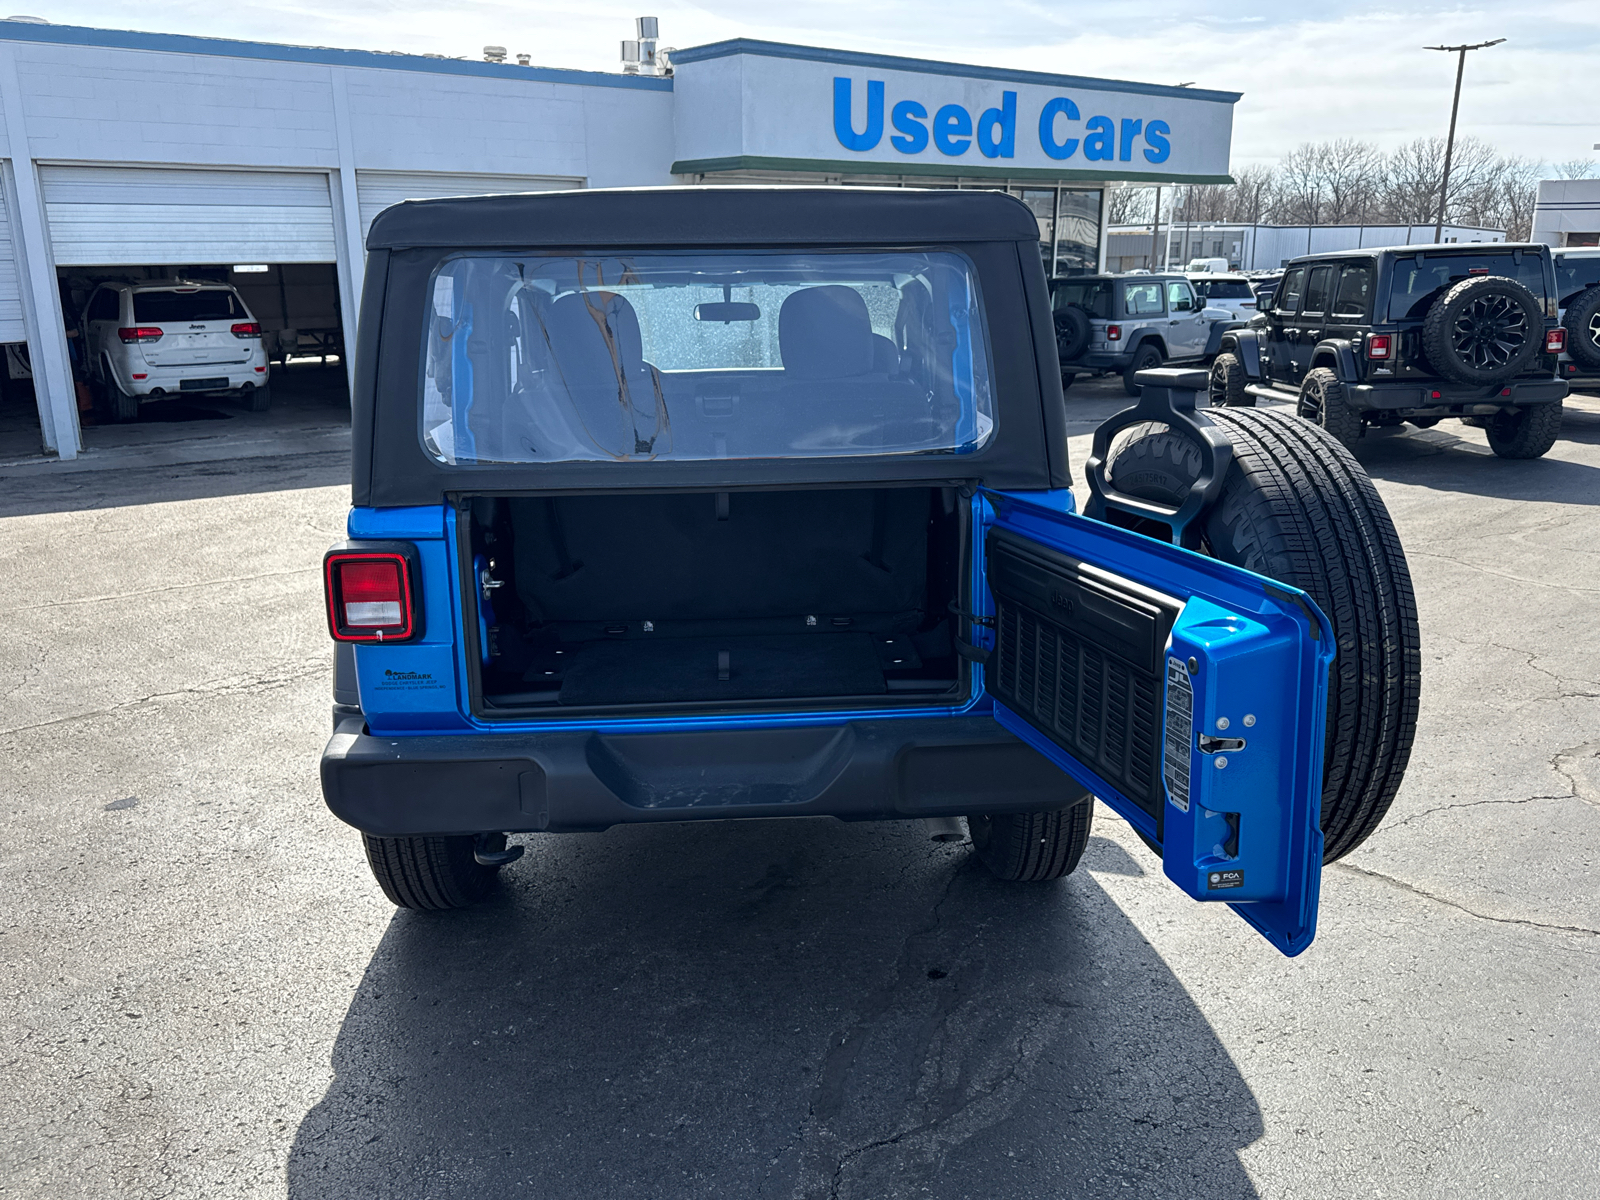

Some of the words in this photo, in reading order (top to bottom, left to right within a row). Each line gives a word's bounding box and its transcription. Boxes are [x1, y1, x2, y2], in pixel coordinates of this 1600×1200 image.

[833, 76, 1017, 159] Used
[1038, 96, 1171, 164] Cars
[1051, 588, 1074, 616] Jeep
[392, 673, 433, 681] LANDMARK
[1223, 872, 1240, 880] FCA
